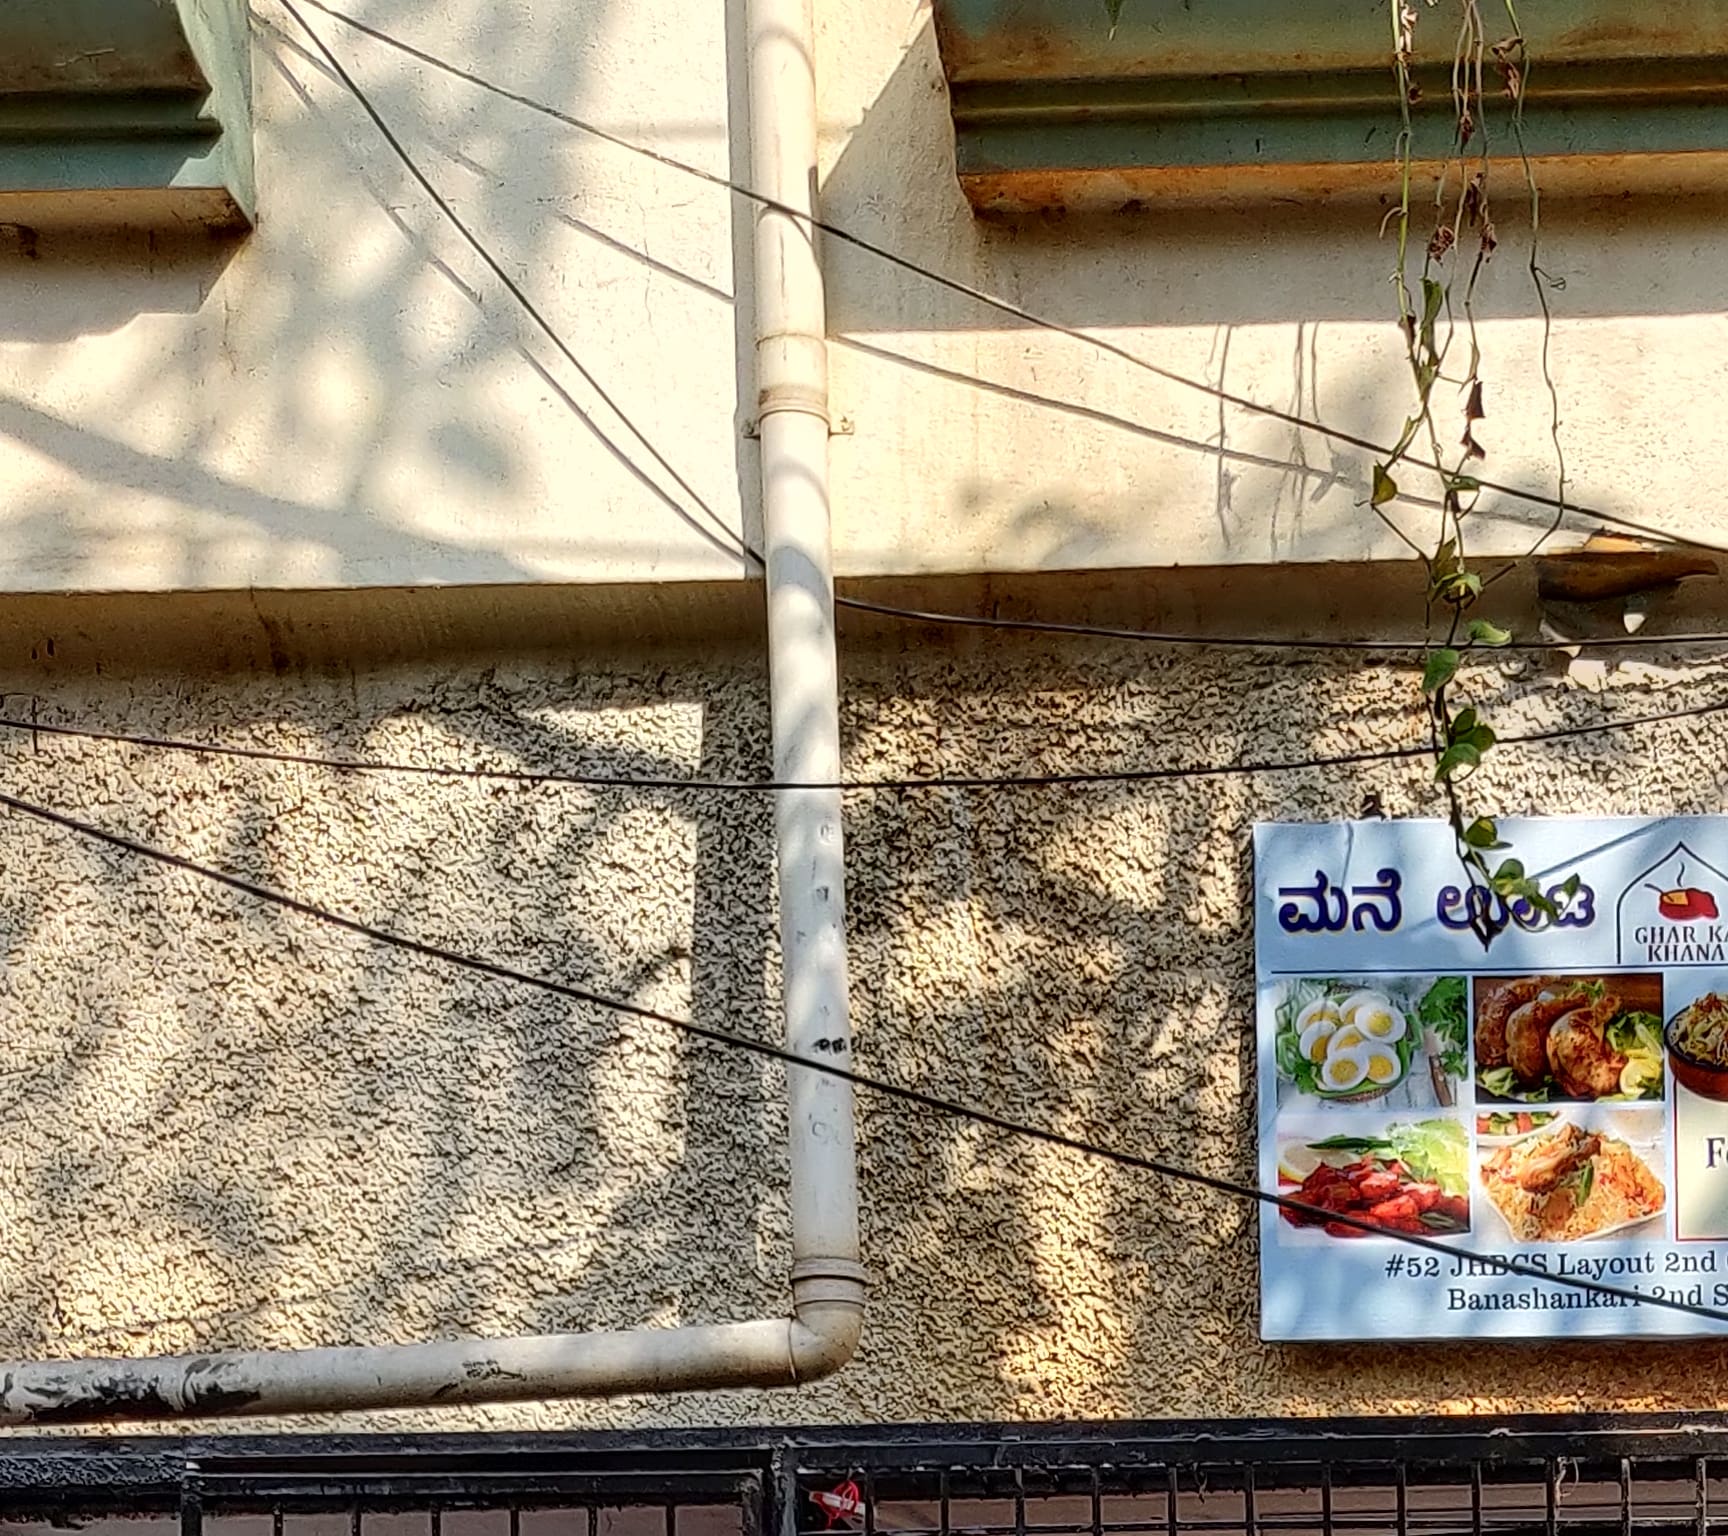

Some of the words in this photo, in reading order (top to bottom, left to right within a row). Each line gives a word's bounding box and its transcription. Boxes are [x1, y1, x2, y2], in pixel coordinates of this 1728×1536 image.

[1278, 868, 1402, 933] ಮನೆ
[1635, 926, 1697, 946] GHAR
[1648, 943, 1726, 962] KHANA
[1385, 1254, 1440, 1278] #52
[1558, 1252, 1656, 1282] Layout
[1665, 1250, 1717, 1273] 2nd
[1447, 1283, 1641, 1312] Banashankari
[1651, 1283, 1704, 1307] 2nd
